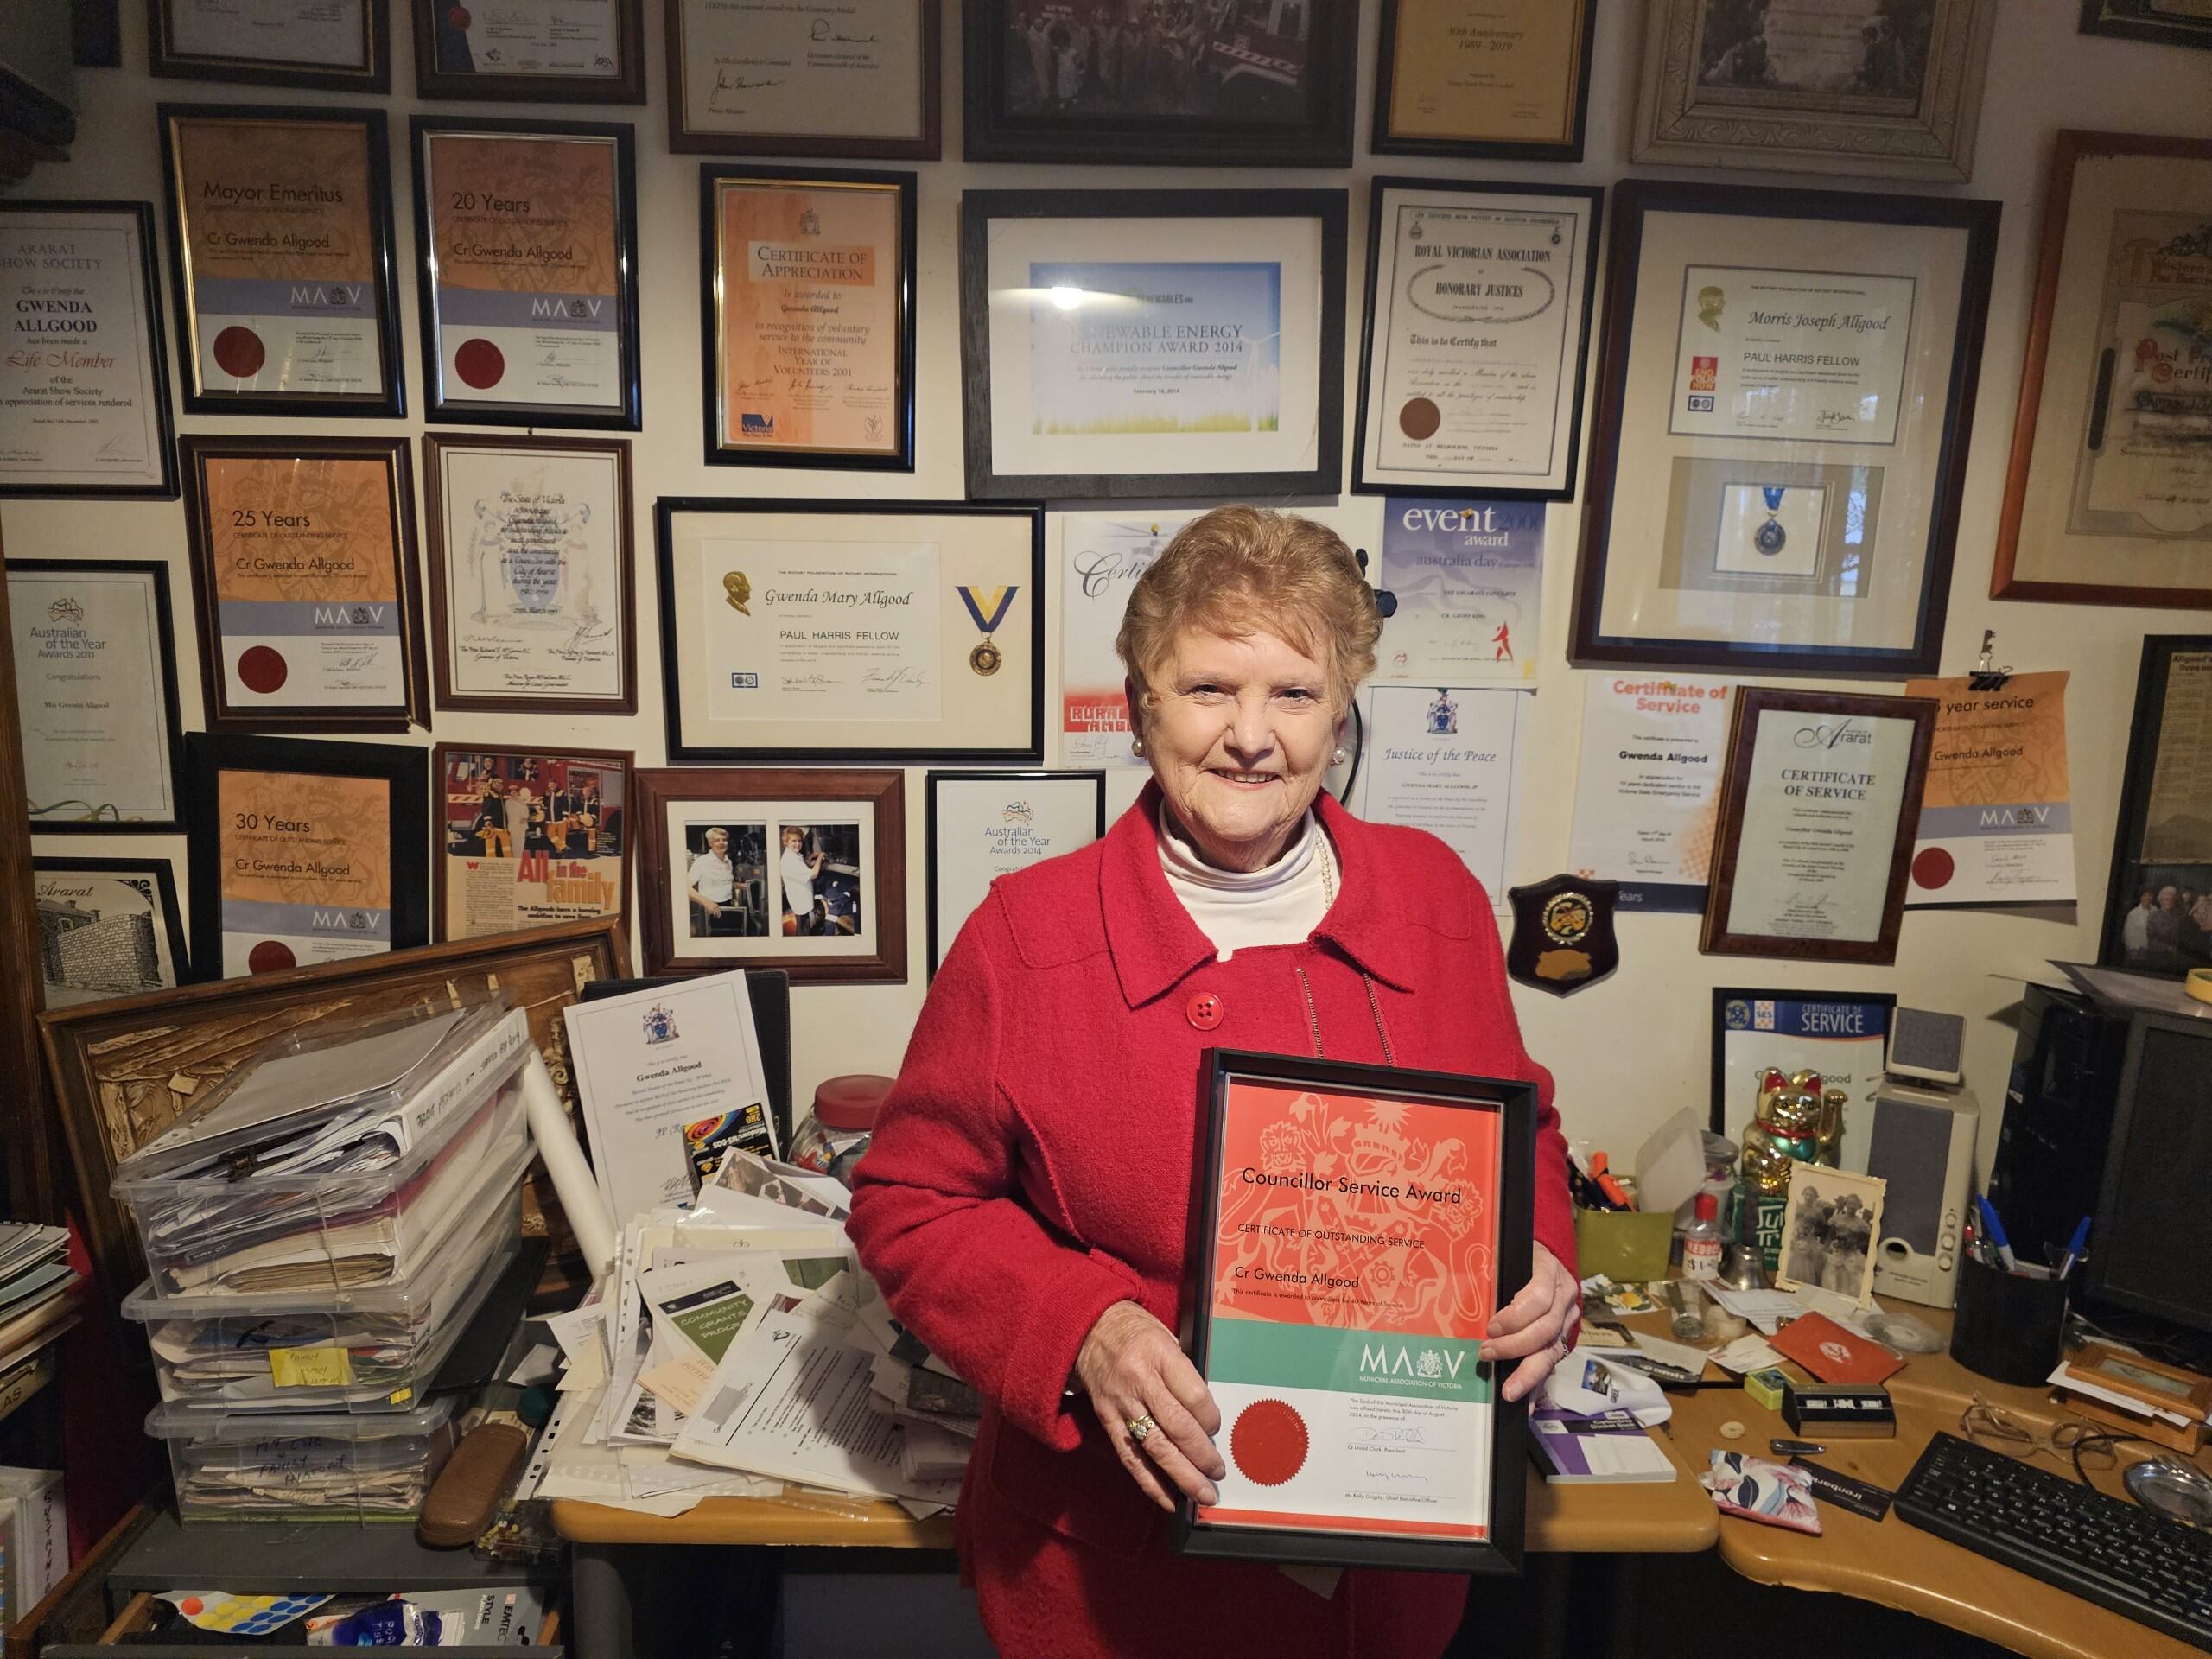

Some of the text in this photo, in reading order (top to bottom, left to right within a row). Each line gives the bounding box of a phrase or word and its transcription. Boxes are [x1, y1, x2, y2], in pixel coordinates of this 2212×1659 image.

[1490, 41, 1513, 51] 2019
[203, 181, 344, 207] Mayor Emeritus
[452, 192, 531, 214] 20 Years
[17, 243, 77, 256] ARARAT
[207, 232, 330, 251] Cr Gwenda Allgood
[454, 243, 468, 257] Cr
[472, 244, 523, 260] Gwenda
[526, 245, 574, 264] Allgood
[757, 245, 867, 265] CERTIFICATE OF
[1414, 245, 1552, 263] ROYAL VICTORIAN ASSOCIATION
[42, 258, 104, 270] SOCIETY
[761, 264, 864, 282] APPRECIATION
[793, 289, 830, 301] awarded
[1435, 282, 1524, 299] HONORARY JUSTICES
[16, 299, 93, 315] GWENDA
[13, 319, 99, 334] ALLGOOD
[766, 321, 871, 336] recognition voluntary
[1748, 310, 1892, 334] Morris Joseph Allgood
[759, 333, 867, 346] service the community
[1071, 324, 1244, 340] ENEWABLE ENERGY
[777, 346, 849, 359] INTERNATIONAL
[1070, 340, 1243, 354] CHAMPION AWARD 2014
[1743, 352, 1861, 367] PAUL HARRIS FELLOW
[773, 364, 853, 378] VOLUNTEERS 2001
[60, 375, 73, 385] the
[22, 385, 103, 397] Ararat Show Society
[5, 397, 132, 408] appreciation services rendered
[232, 510, 311, 528] 25 Years
[1402, 505, 1497, 533] event
[1465, 531, 1510, 548] award
[236, 557, 355, 574] Cr Gwenda Allgood
[1415, 553, 1498, 570] australia day
[1073, 550, 1147, 603] Certi
[765, 588, 915, 609] Gwenda Mary Allgood
[30, 626, 87, 639] Australian
[779, 630, 899, 642] PAUL HARRIS FELLOW
[45, 638, 107, 651] of the Year
[37, 649, 96, 659] Awards 2011
[1708, 684, 1729, 701] of
[1636, 697, 1701, 714] Service
[1946, 695, 2034, 714] year service
[1070, 705, 1127, 723] RURAL
[1382, 747, 1497, 765] Justice of the Peace
[1618, 750, 1708, 765] Gwenda Allgood
[1934, 746, 2024, 762] Gwenda Allgood
[1781, 767, 1877, 786] CERTIFICATE
[1783, 785, 1866, 802] OF SERVICE
[235, 813, 311, 834] 30 Years
[984, 826, 1035, 837] Australian
[996, 836, 1052, 847] of the Year
[989, 846, 1043, 856] Awards 2014
[235, 858, 351, 878] Cr Gwenda Allgood
[517, 849, 550, 883] All
[37, 881, 95, 899] Ararat
[545, 870, 616, 911] family
[1802, 1003, 1862, 1014] CERTIFICATE OF
[1801, 1013, 1865, 1033] SERVICE
[636, 1060, 702, 1084] Gwenda Allgood
[1243, 1166, 1462, 1205] Councillor Service Award
[1237, 1222, 1426, 1249] CERTIFICATE OF OUTSTANDING SERVICE
[1234, 1265, 1360, 1291] Cr Gwenda Allgood
[1246, 1289, 1272, 1298] certificate
[1279, 1291, 1304, 1300] awarded
[1311, 1294, 1342, 1304] councillors
[701, 1320, 743, 1339] PROGR
[1359, 1376, 1389, 1384] MUNICIPAL
[1389, 1377, 1428, 1388] ASSOCIATION
[1437, 1381, 1464, 1391] VICTORIA
[481, 1593, 495, 1625] STYLE
[496, 1603, 514, 1643] EMTEC
